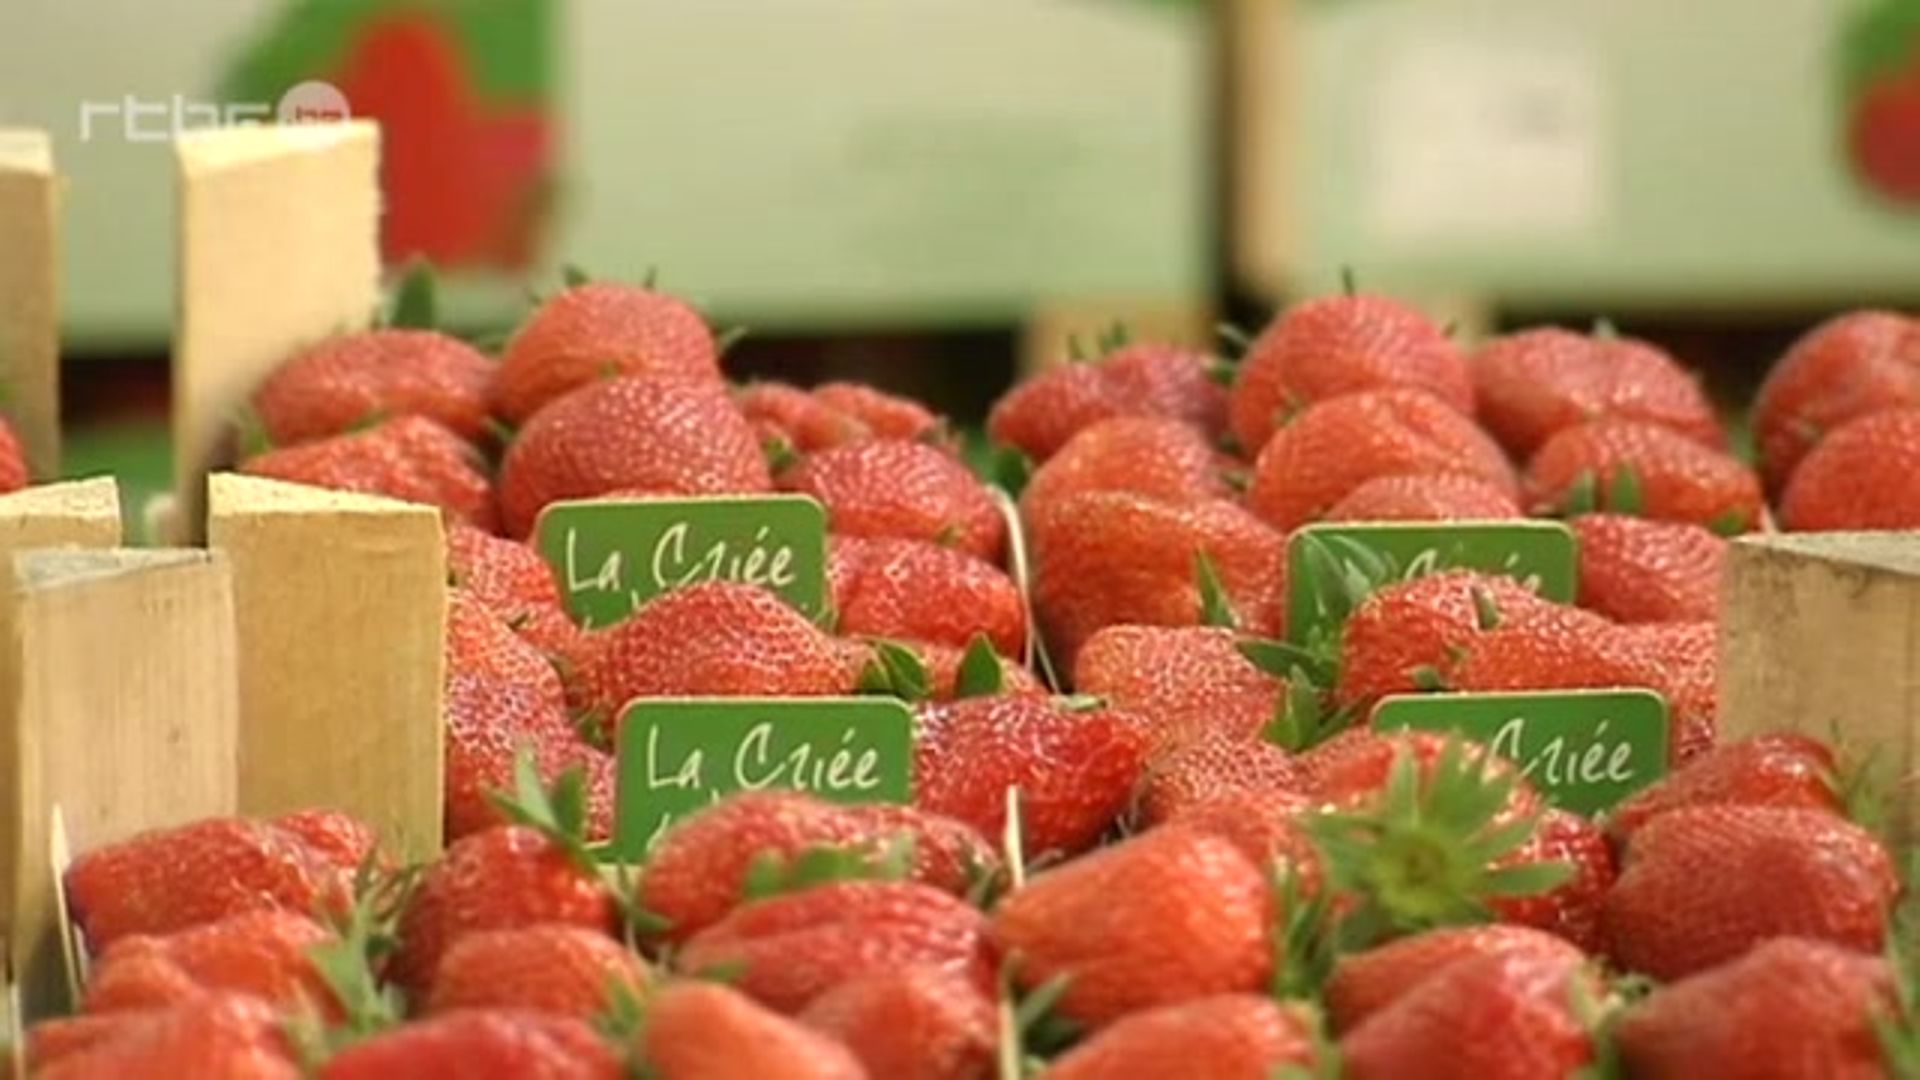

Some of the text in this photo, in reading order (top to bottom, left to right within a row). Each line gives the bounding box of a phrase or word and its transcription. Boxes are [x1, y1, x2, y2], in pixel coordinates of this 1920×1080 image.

[567, 521, 796, 591] La Criée
[648, 722, 880, 791] La Criée
